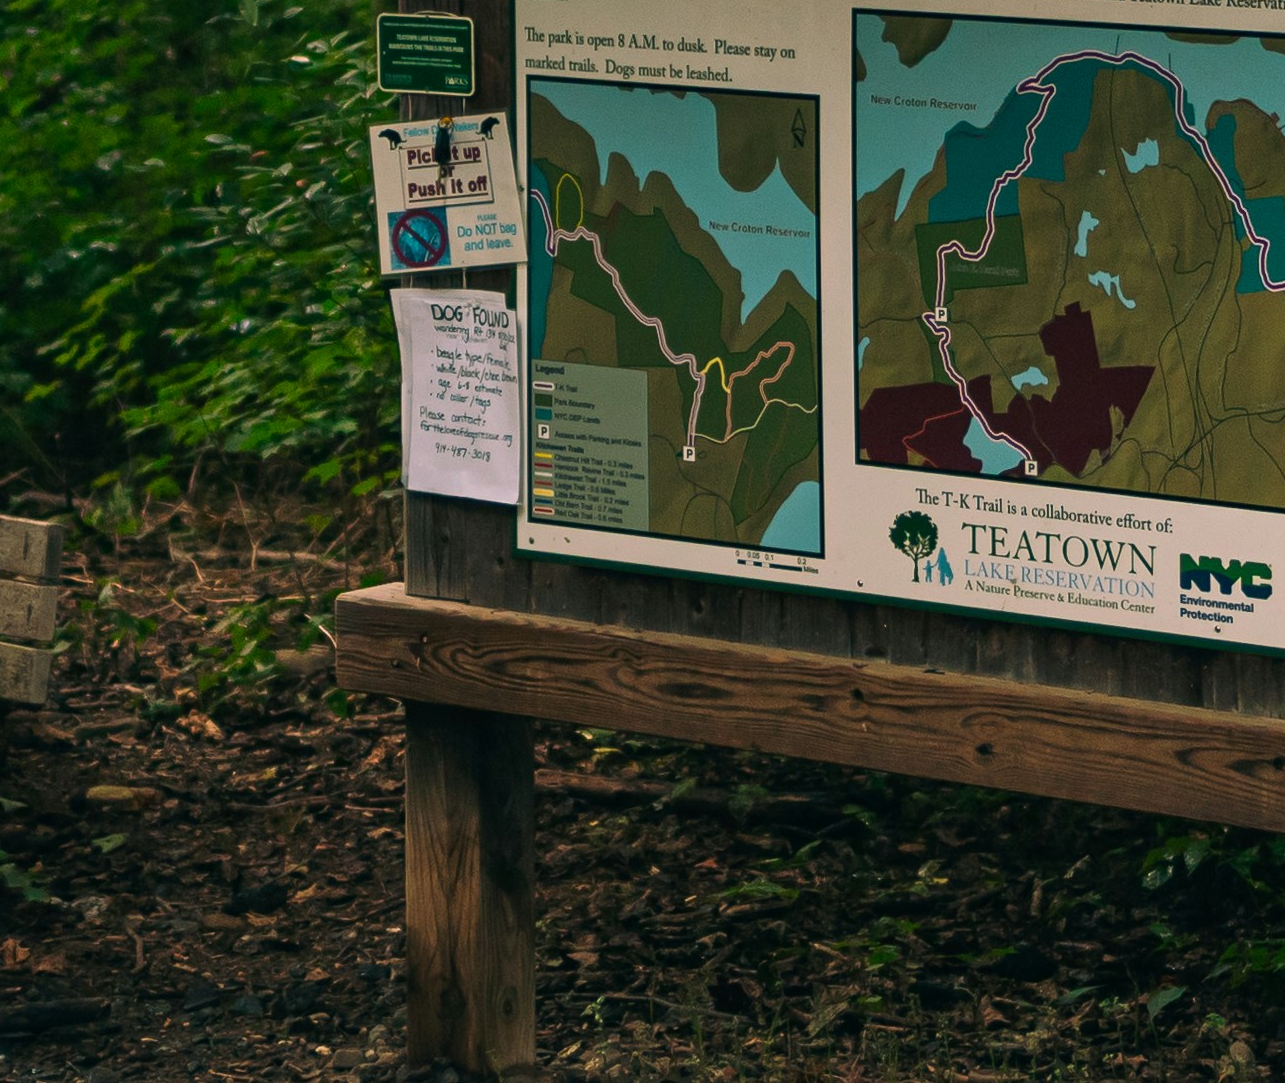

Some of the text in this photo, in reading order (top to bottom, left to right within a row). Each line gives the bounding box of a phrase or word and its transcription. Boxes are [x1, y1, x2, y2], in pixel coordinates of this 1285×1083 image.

[524, 28, 796, 62] The park is open 8 A.M. to dusk. Please stay on
[525, 55, 733, 82] marked trails. Dogs must be leashed.
[871, 95, 977, 110] New Croton Reservoir
[407, 147, 480, 165] Pic up
[408, 180, 446, 198] Push
[468, 176, 487, 192] off
[458, 223, 516, 237] Do NOT bag
[708, 220, 810, 238] New Croton Reservoir
[464, 237, 513, 251] and leave.
[431, 304, 509, 328] DOG FOUND
[915, 488, 1173, 534] The T-K Trail is a collaborative effort of:
[961, 522, 1156, 576] TEATOWN
[965, 559, 1155, 598] LAKE RESERVATION
[1179, 553, 1272, 600] NYC
[964, 580, 1155, 614] A Nature Preserve & Education Center
[1180, 594, 1254, 613] Environmental
[1180, 607, 1234, 624] Protection
